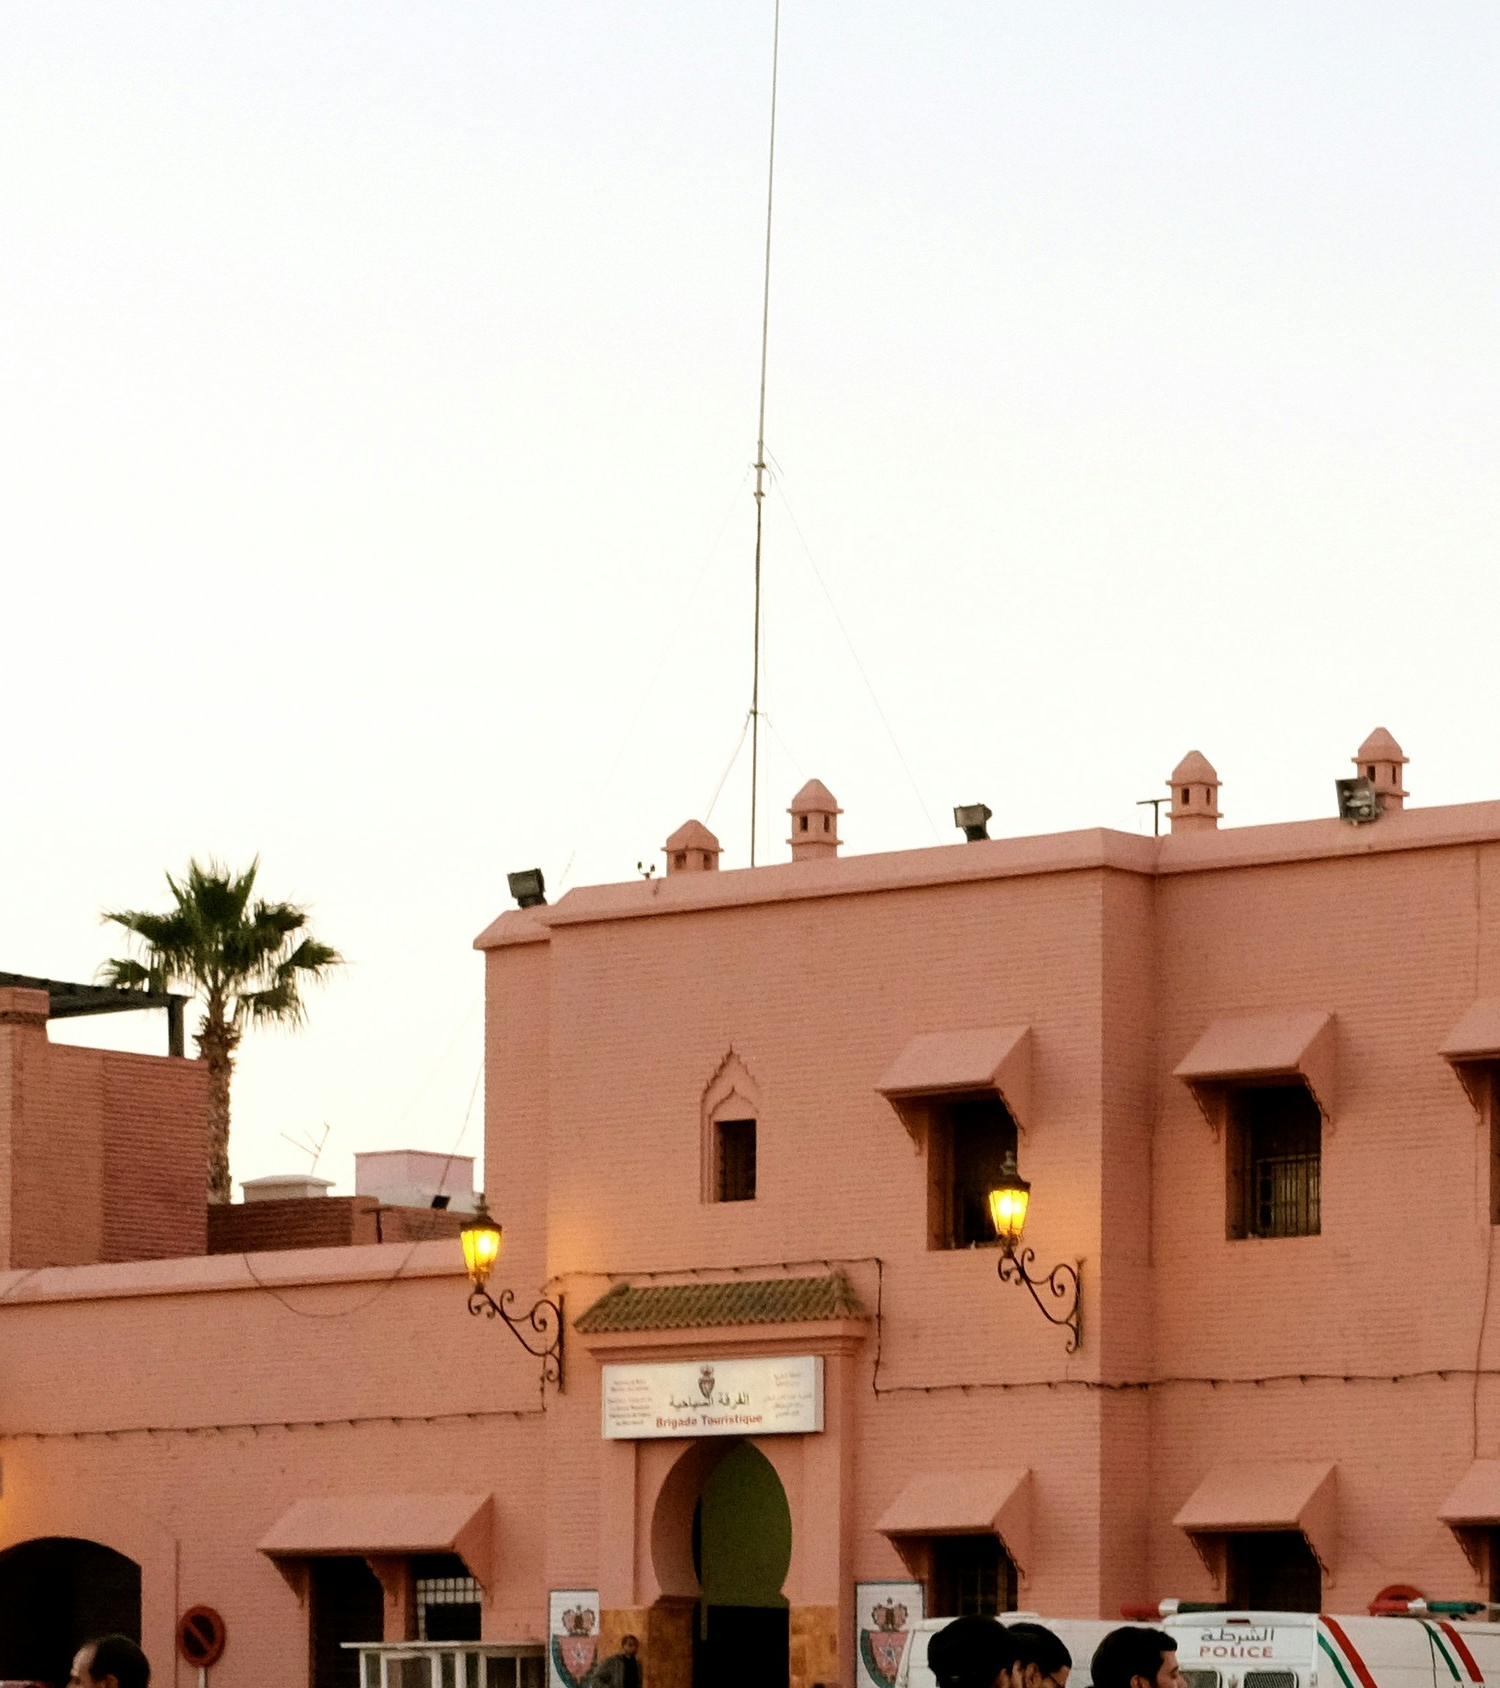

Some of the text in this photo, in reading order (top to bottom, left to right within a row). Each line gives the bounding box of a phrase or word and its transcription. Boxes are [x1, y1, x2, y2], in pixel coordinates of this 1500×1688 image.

[655, 1416, 698, 1430] Brigade
[702, 1414, 763, 1427] Touristique
[1201, 1626, 1275, 1646] الشرطة
[1199, 1645, 1274, 1658] POLICE
